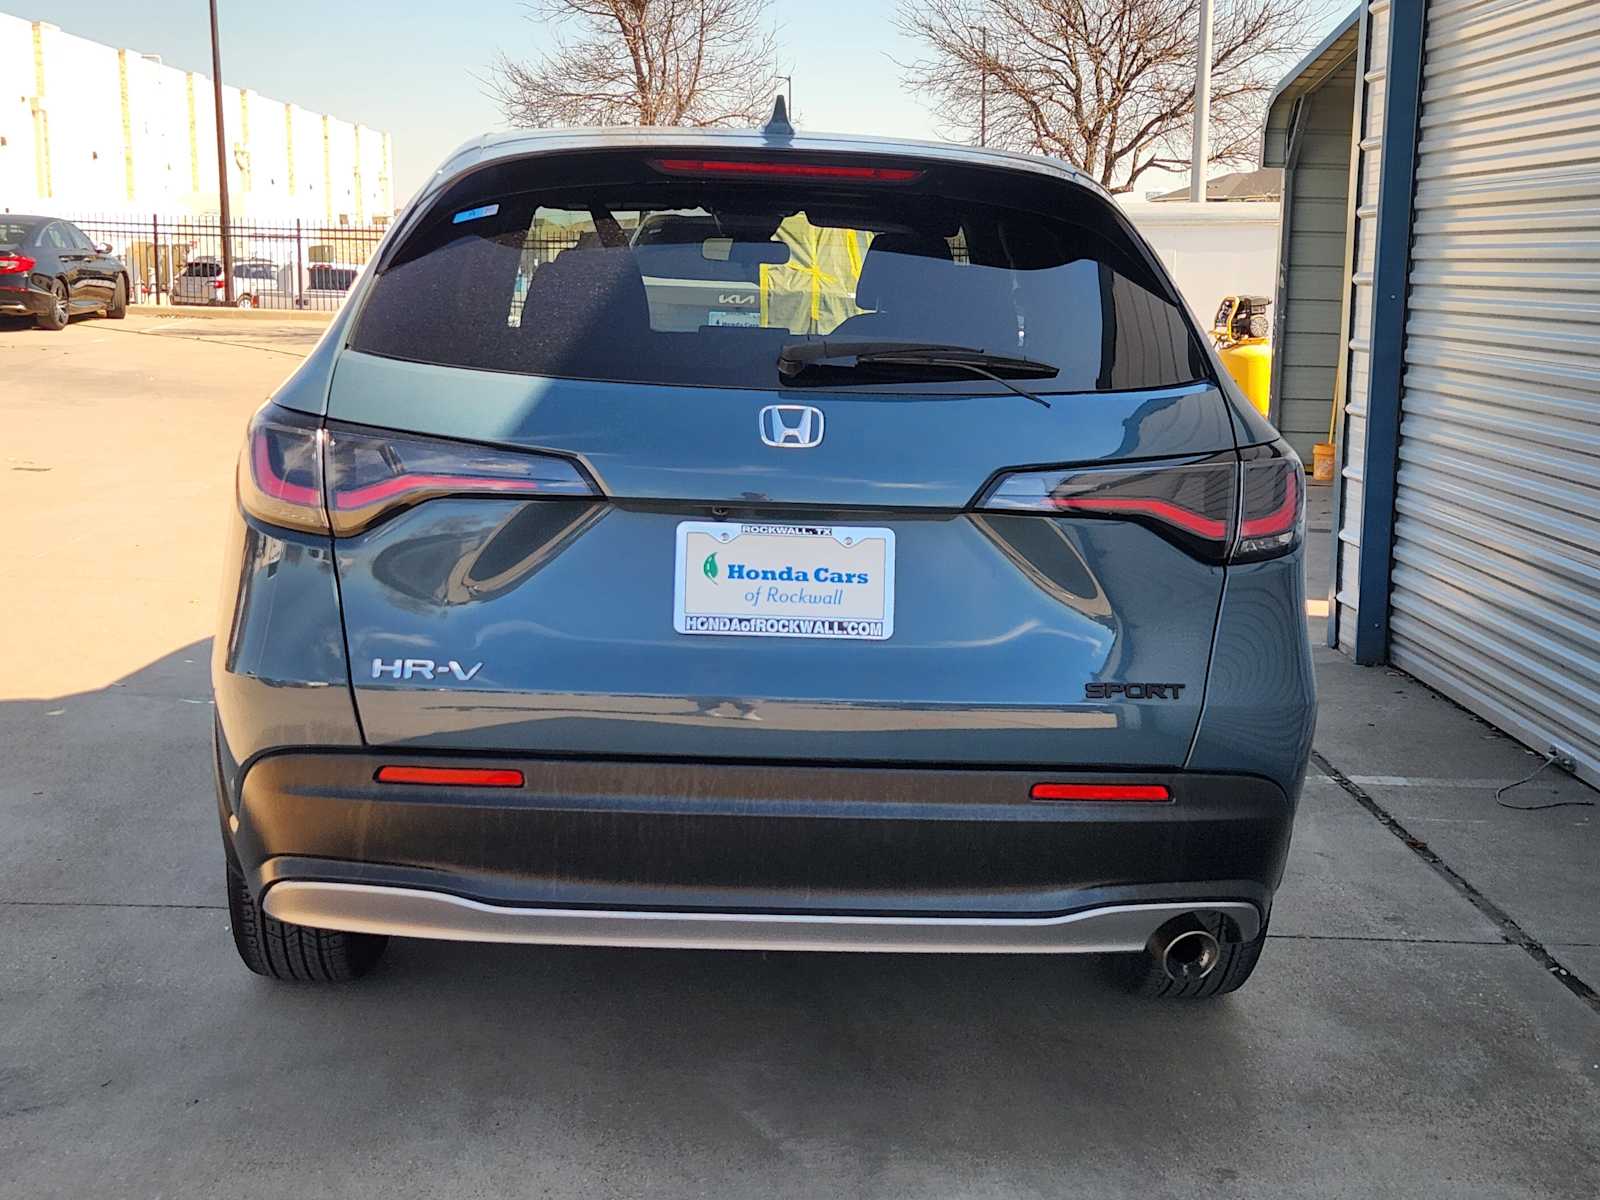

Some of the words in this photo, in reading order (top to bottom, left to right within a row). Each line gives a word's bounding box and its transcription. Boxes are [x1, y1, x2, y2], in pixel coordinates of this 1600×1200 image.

[815, 528, 832, 536] TX
[727, 564, 809, 582] Honda
[813, 567, 869, 584] Cars
[744, 585, 763, 607] of
[767, 586, 844, 605] Rockwall
[685, 617, 882, 637] HONDAofROCKWALL.COM
[371, 658, 484, 681] HR-V
[1085, 682, 1186, 700] SPORT
